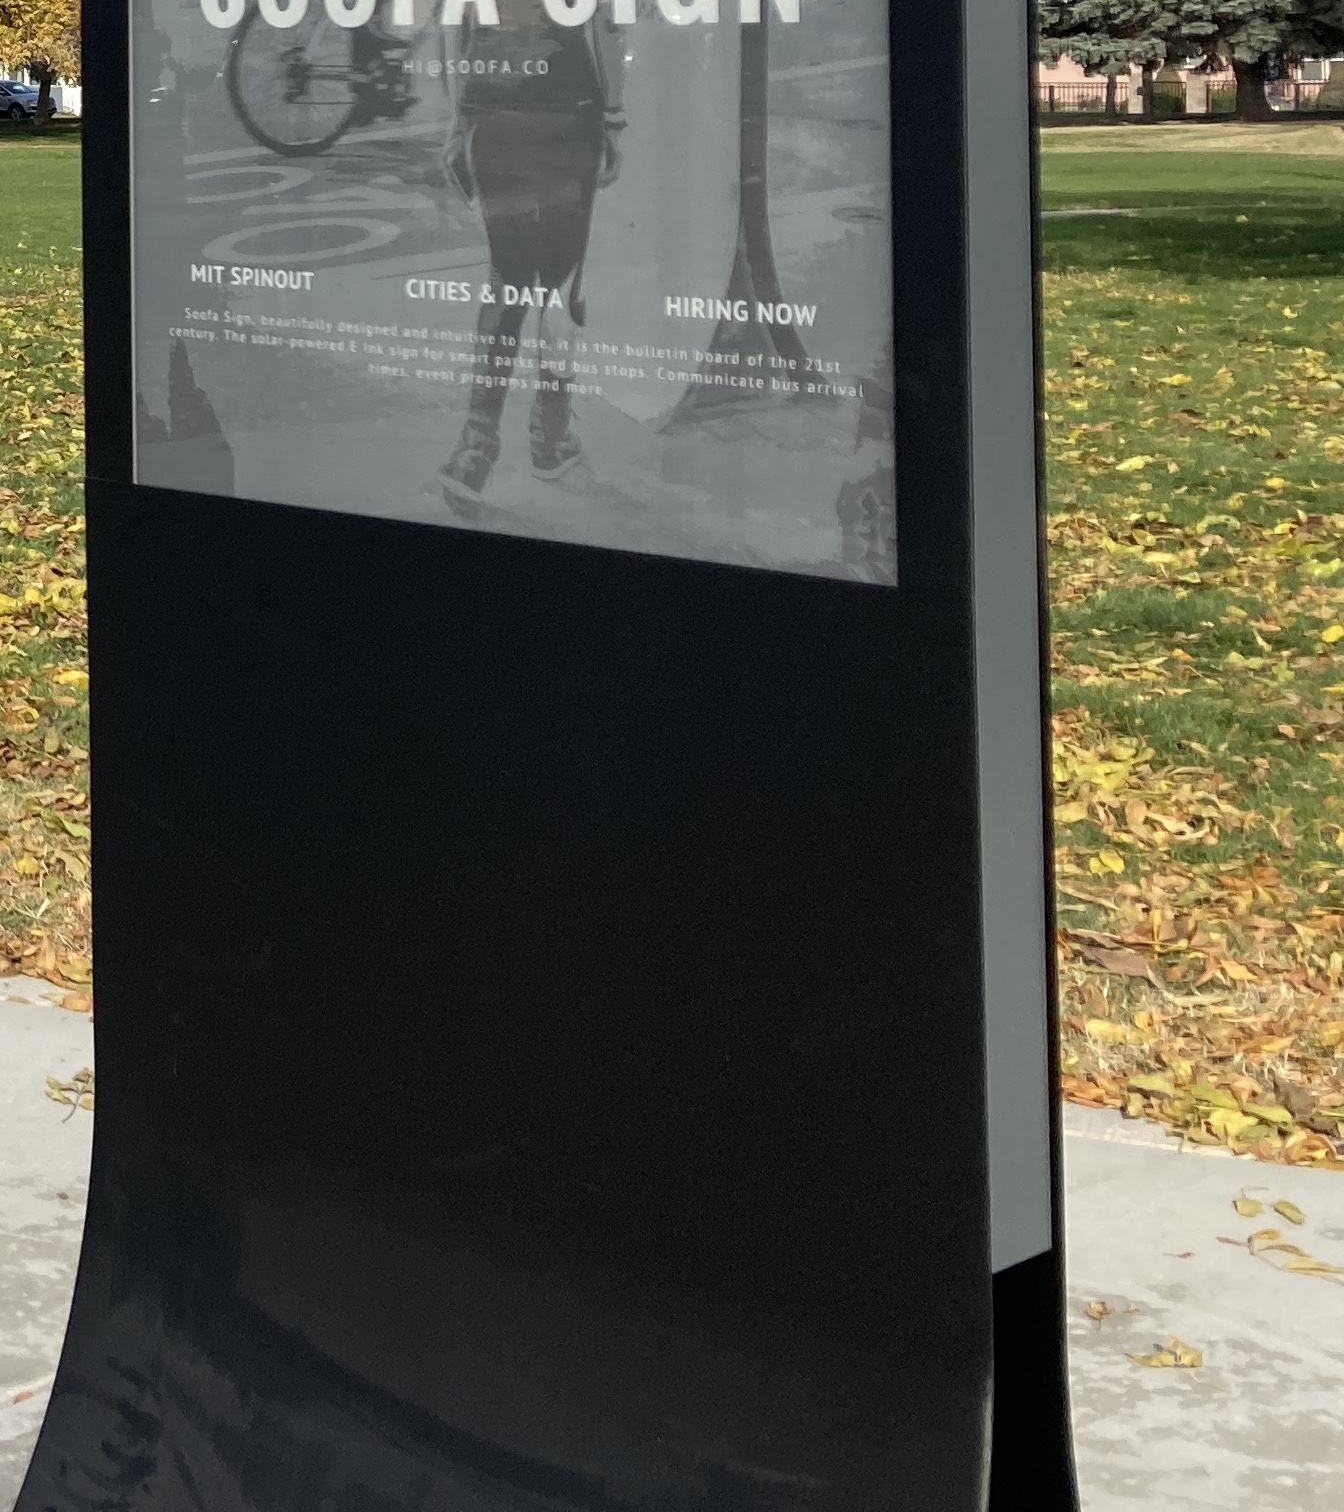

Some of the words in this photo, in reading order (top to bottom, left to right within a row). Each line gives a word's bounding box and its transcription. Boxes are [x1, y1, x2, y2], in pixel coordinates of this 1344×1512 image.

[191, 263, 224, 284] MIT
[229, 265, 314, 290] SPINOUT
[406, 278, 471, 303] CITIES
[480, 283, 495, 304] &
[504, 284, 563, 309] DATA
[666, 295, 748, 322] HIRING
[758, 301, 816, 326] NOW
[184, 306, 219, 323] Soofa
[260, 312, 331, 335] beautifully
[337, 318, 398, 337] designed
[403, 324, 428, 339] and
[501, 331, 516, 346] to
[576, 337, 588, 352] is
[594, 339, 619, 354] the
[625, 341, 687, 360] bulletin
[694, 347, 739, 364] board
[747, 351, 763, 366] of
[770, 353, 796, 368] the
[805, 355, 840, 372] 21st
[223, 330, 247, 345] The
[390, 344, 418, 363] sign
[448, 349, 488, 366] smart
[540, 356, 565, 372] and
[572, 359, 598, 375] bus
[657, 366, 764, 389] Communicate
[771, 376, 799, 392] bus
[807, 379, 863, 398] arrival
[459, 373, 527, 389] programs
[533, 377, 559, 392] and
